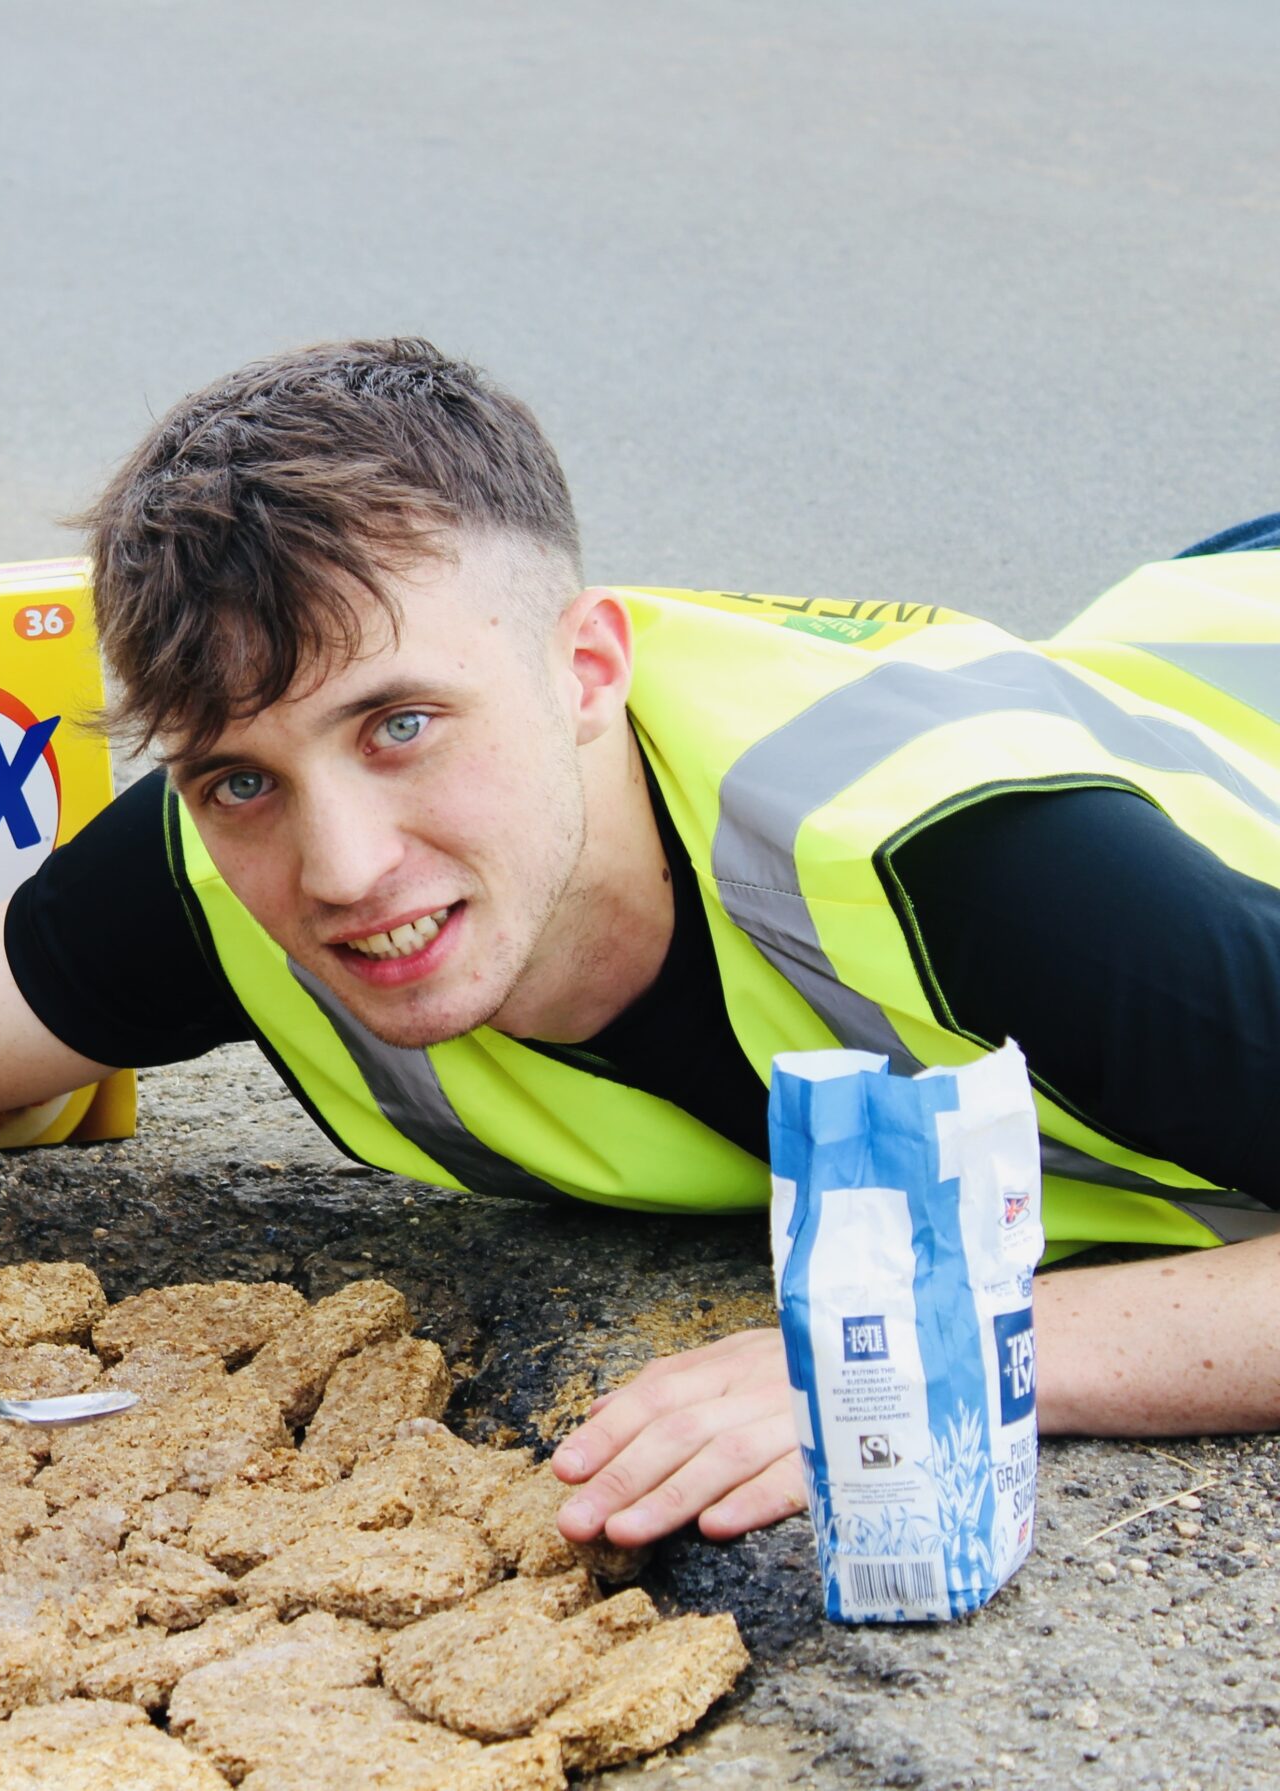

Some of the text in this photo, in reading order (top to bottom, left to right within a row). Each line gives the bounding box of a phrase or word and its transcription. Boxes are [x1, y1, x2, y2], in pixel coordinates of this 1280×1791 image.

[25, 607, 64, 637] 36
[848, 1324, 882, 1340] TATE
[851, 1338, 884, 1353] LYLE
[1006, 1328, 1035, 1368] TA
